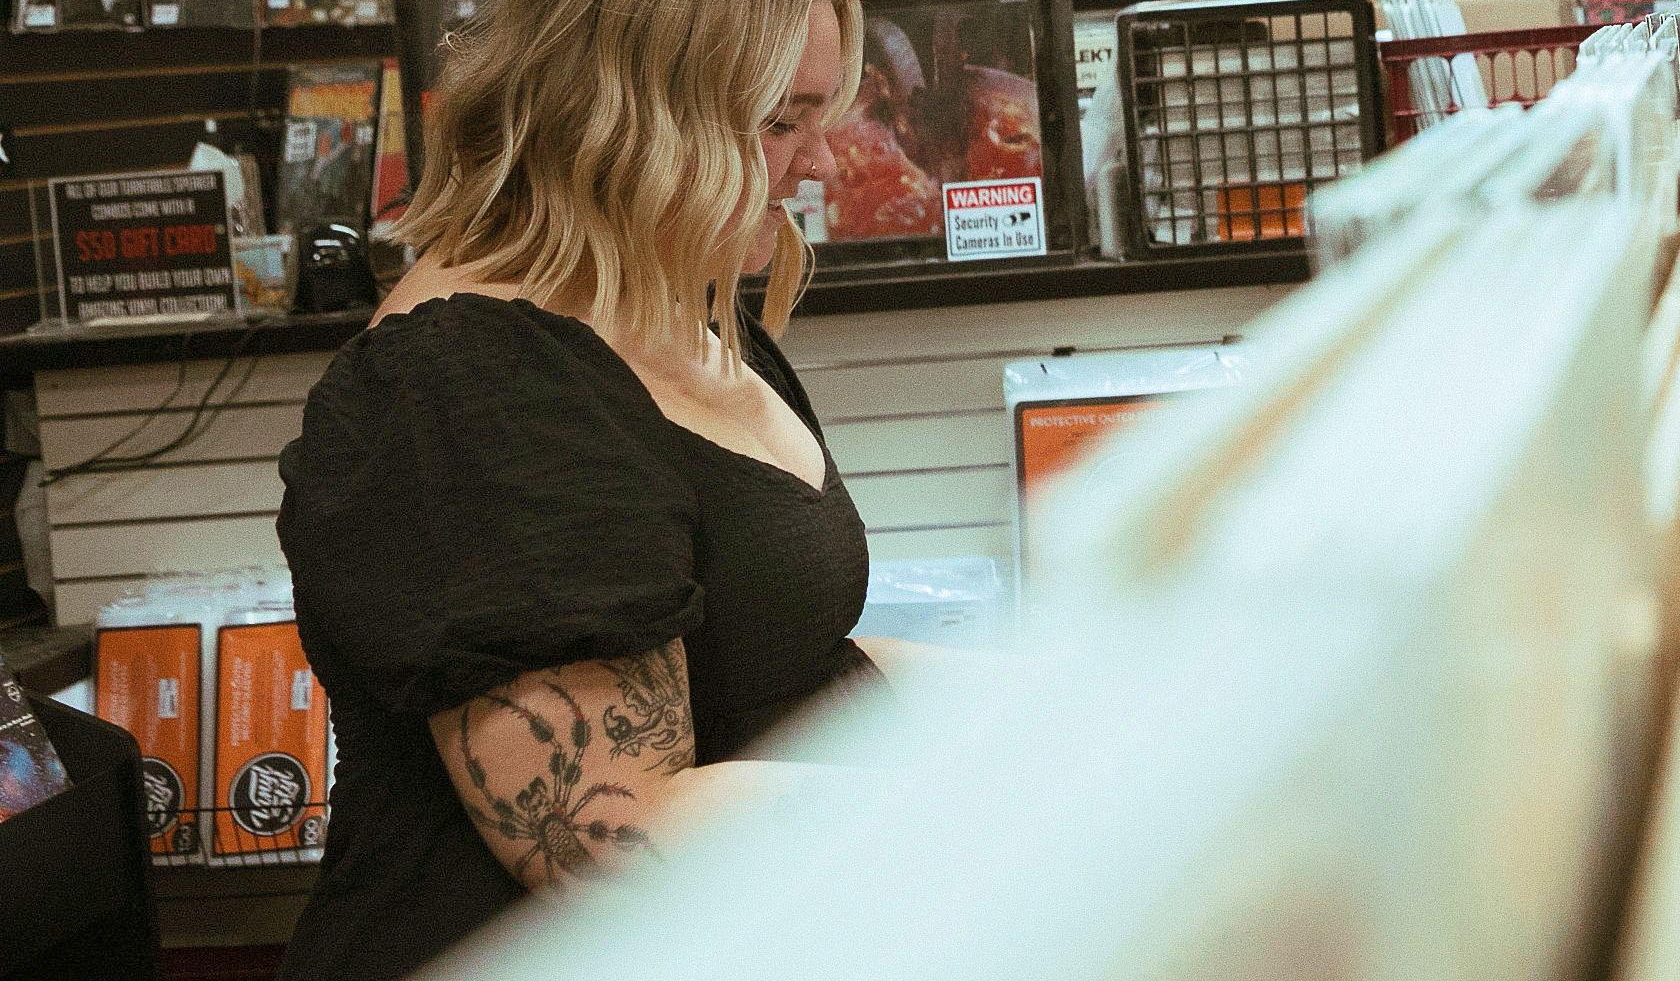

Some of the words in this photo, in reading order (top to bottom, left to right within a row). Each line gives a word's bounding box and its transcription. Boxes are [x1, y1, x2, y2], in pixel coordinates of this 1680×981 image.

[950, 185, 1034, 208] WARNING
[954, 213, 999, 233] Security
[120, 227, 159, 259] GIFT
[956, 235, 1000, 250] Cameras
[1002, 232, 1013, 247] In
[1015, 231, 1034, 247] Use
